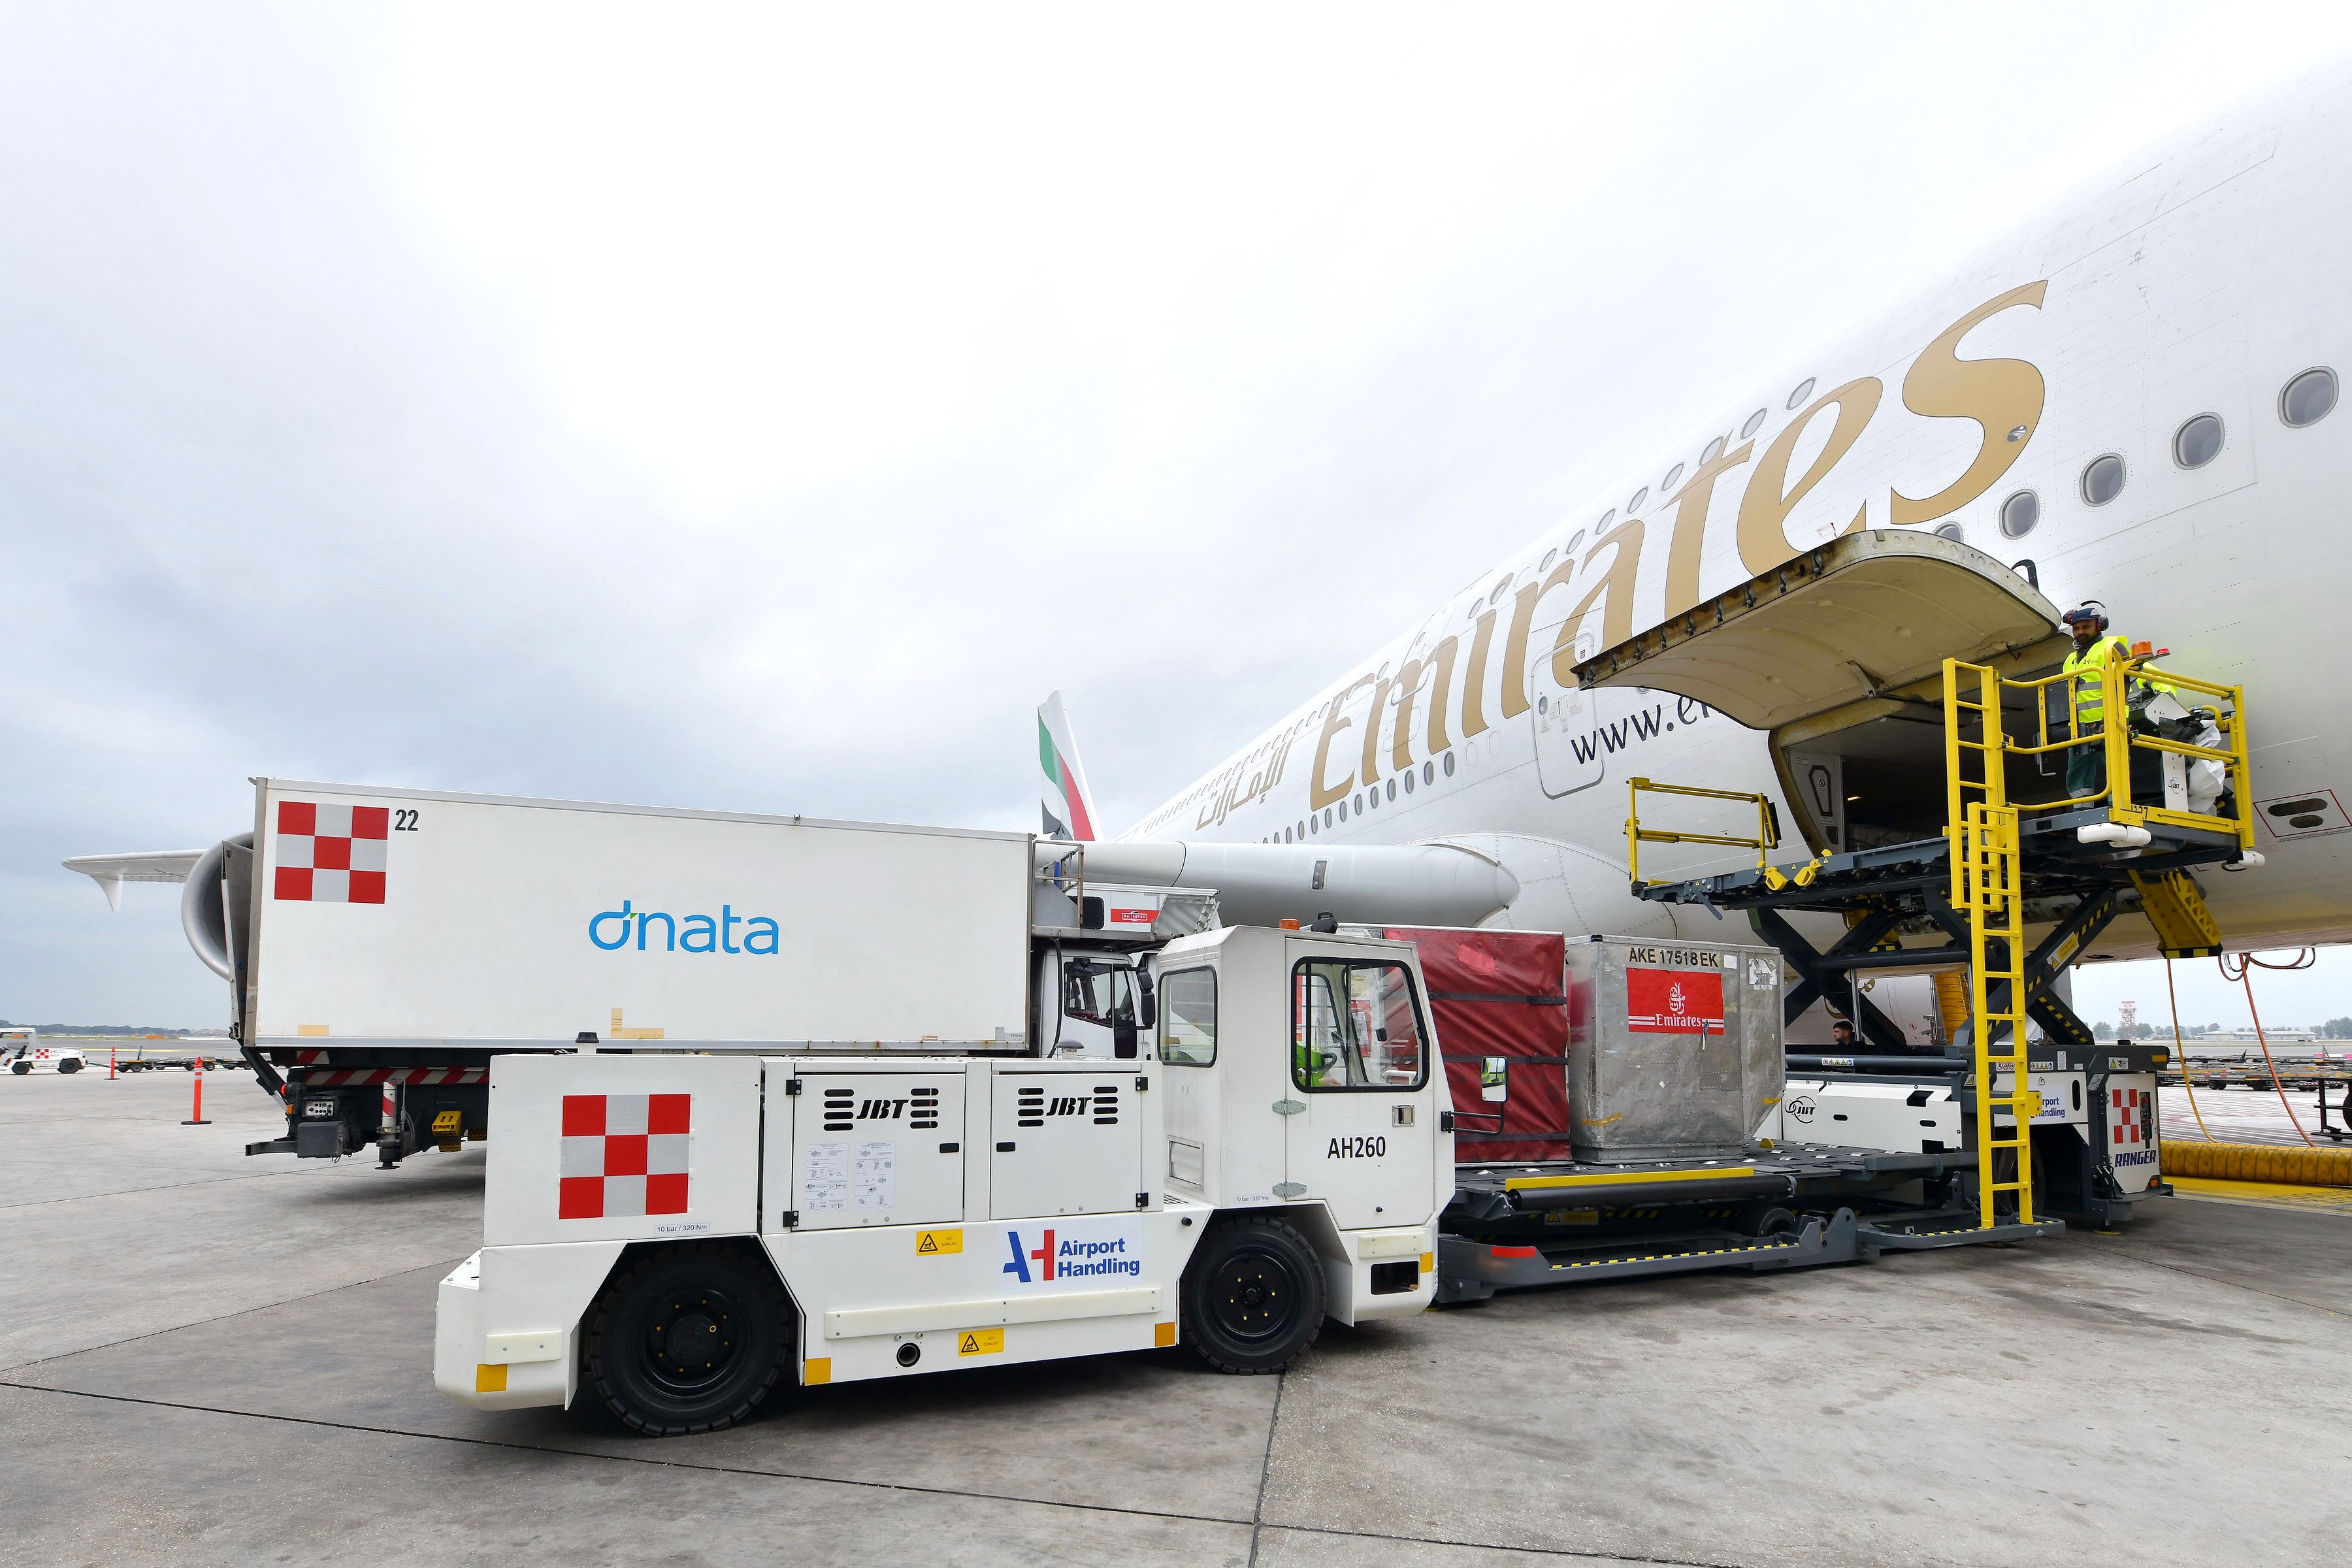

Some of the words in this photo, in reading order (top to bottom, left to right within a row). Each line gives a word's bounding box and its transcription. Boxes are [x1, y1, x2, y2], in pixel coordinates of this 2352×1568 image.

[1311, 279, 2049, 812] Emirates
[394, 809, 419, 832] 22
[589, 900, 779, 955] dnata
[1629, 947, 1657, 964] AKE
[1660, 949, 1699, 966] 17518
[1700, 952, 1719, 968] EK
[1655, 1013, 1702, 1028] Emirates
[857, 1099, 910, 1120] JBT
[1046, 1097, 1092, 1116] JBT
[1797, 1106, 1816, 1115] JBT
[2042, 1097, 2059, 1107] rport
[1328, 1136, 1386, 1159] AH260
[2115, 1150, 2157, 1168] RANGER
[1058, 1237, 1126, 1264] Airport
[1058, 1258, 1141, 1278] Handling
